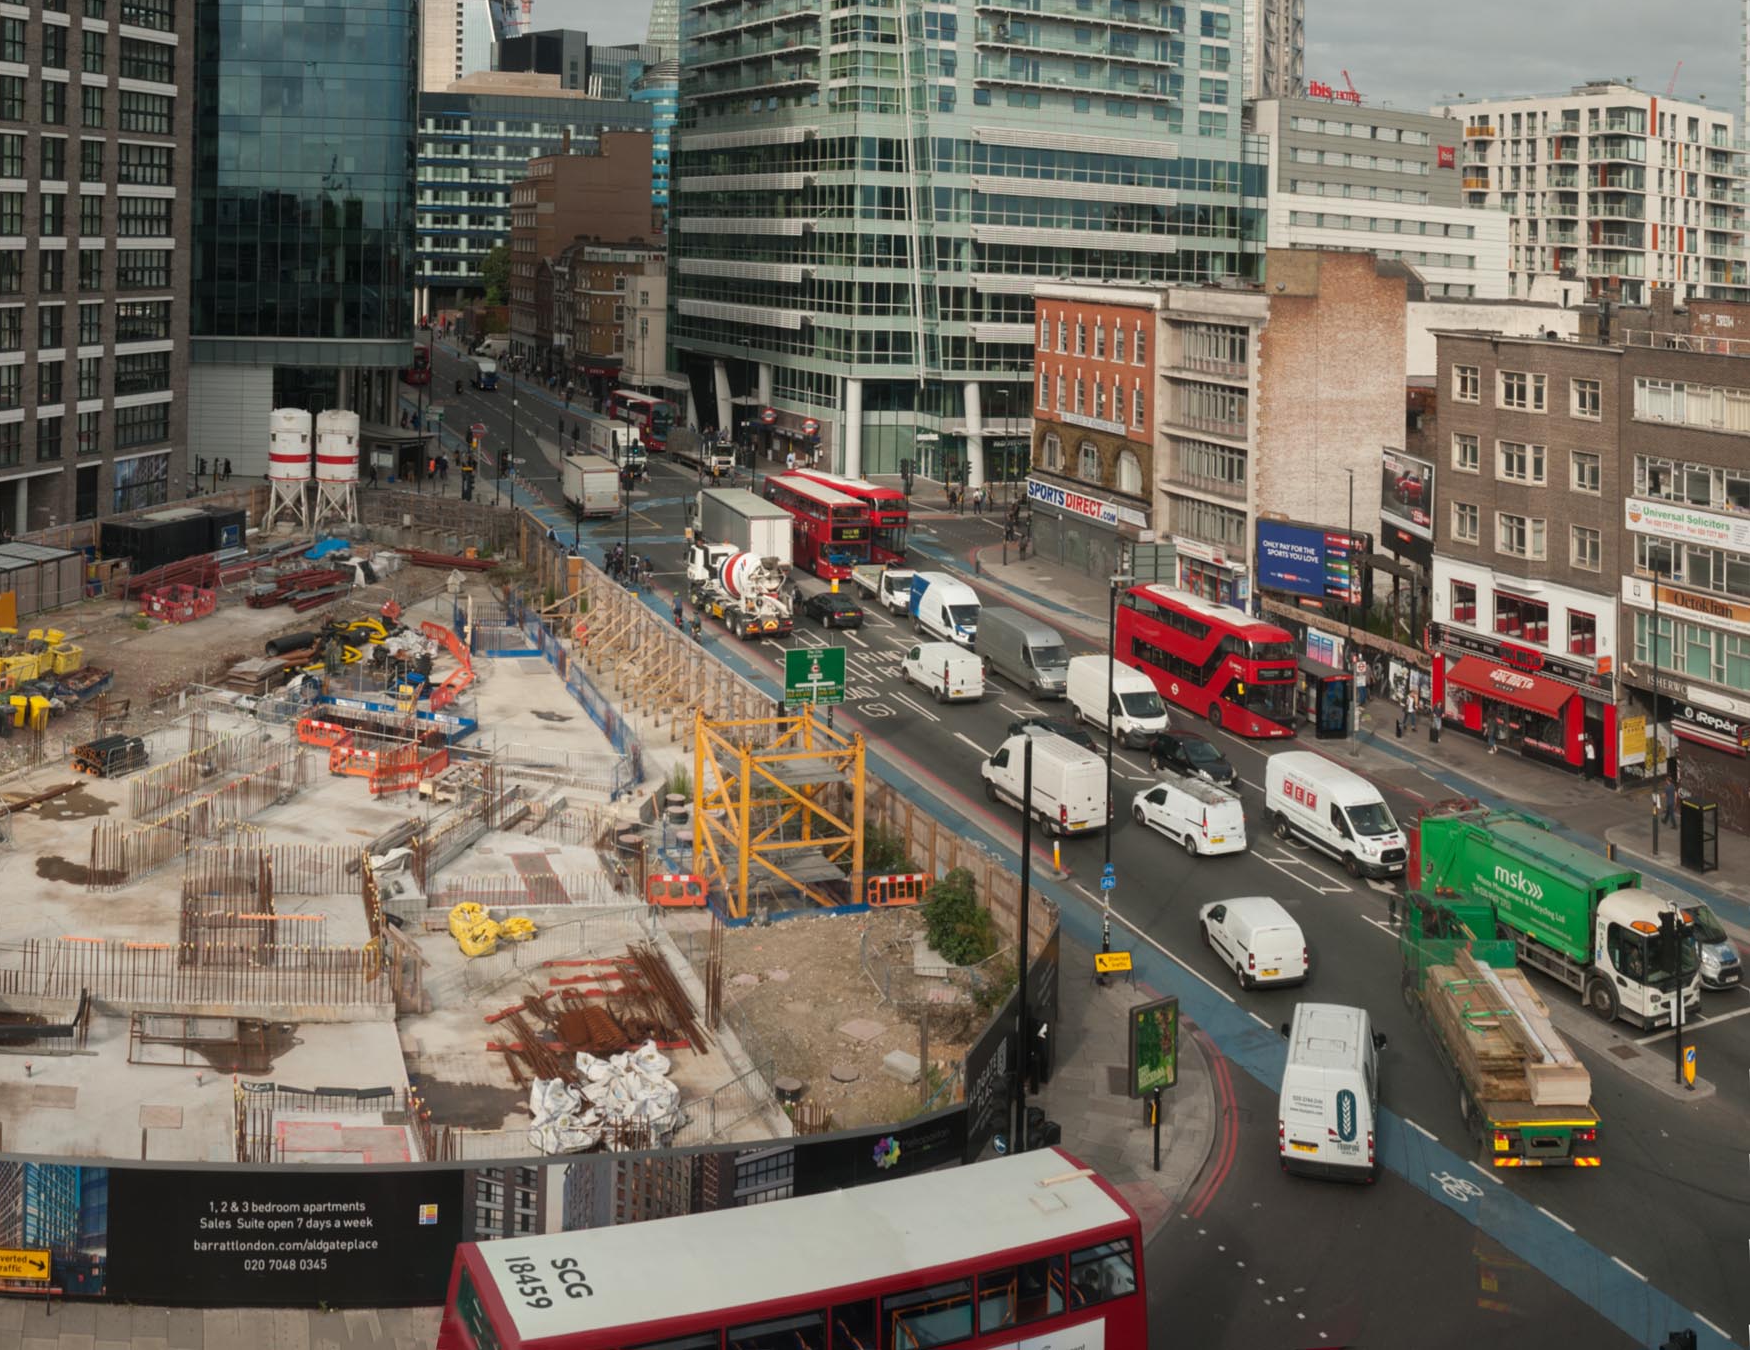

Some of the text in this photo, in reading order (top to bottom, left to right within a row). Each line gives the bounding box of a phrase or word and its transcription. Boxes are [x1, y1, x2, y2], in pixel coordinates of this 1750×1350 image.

[1310, 80, 1332, 98] ibis
[1642, 506, 1685, 522] Universal
[1687, 514, 1730, 531] Solicitors
[1262, 539, 1315, 556] ONLY PAY FOR THE
[1267, 548, 1319, 564] SPORTS YOU LOVE
[1696, 711, 1738, 734] iRepair
[1495, 865, 1526, 893] msk
[209, 1201, 366, 1215] 1, 2 & 3 bedroom apartments
[199, 1217, 374, 1232] Sales Suite open 7 days a week
[193, 1239, 379, 1253] barrattlondon.com/aldgateplace
[244, 1258, 328, 1271] 020 7048 0345
[504, 1256, 553, 1309] 18459
[550, 1257, 594, 1299] SCG
